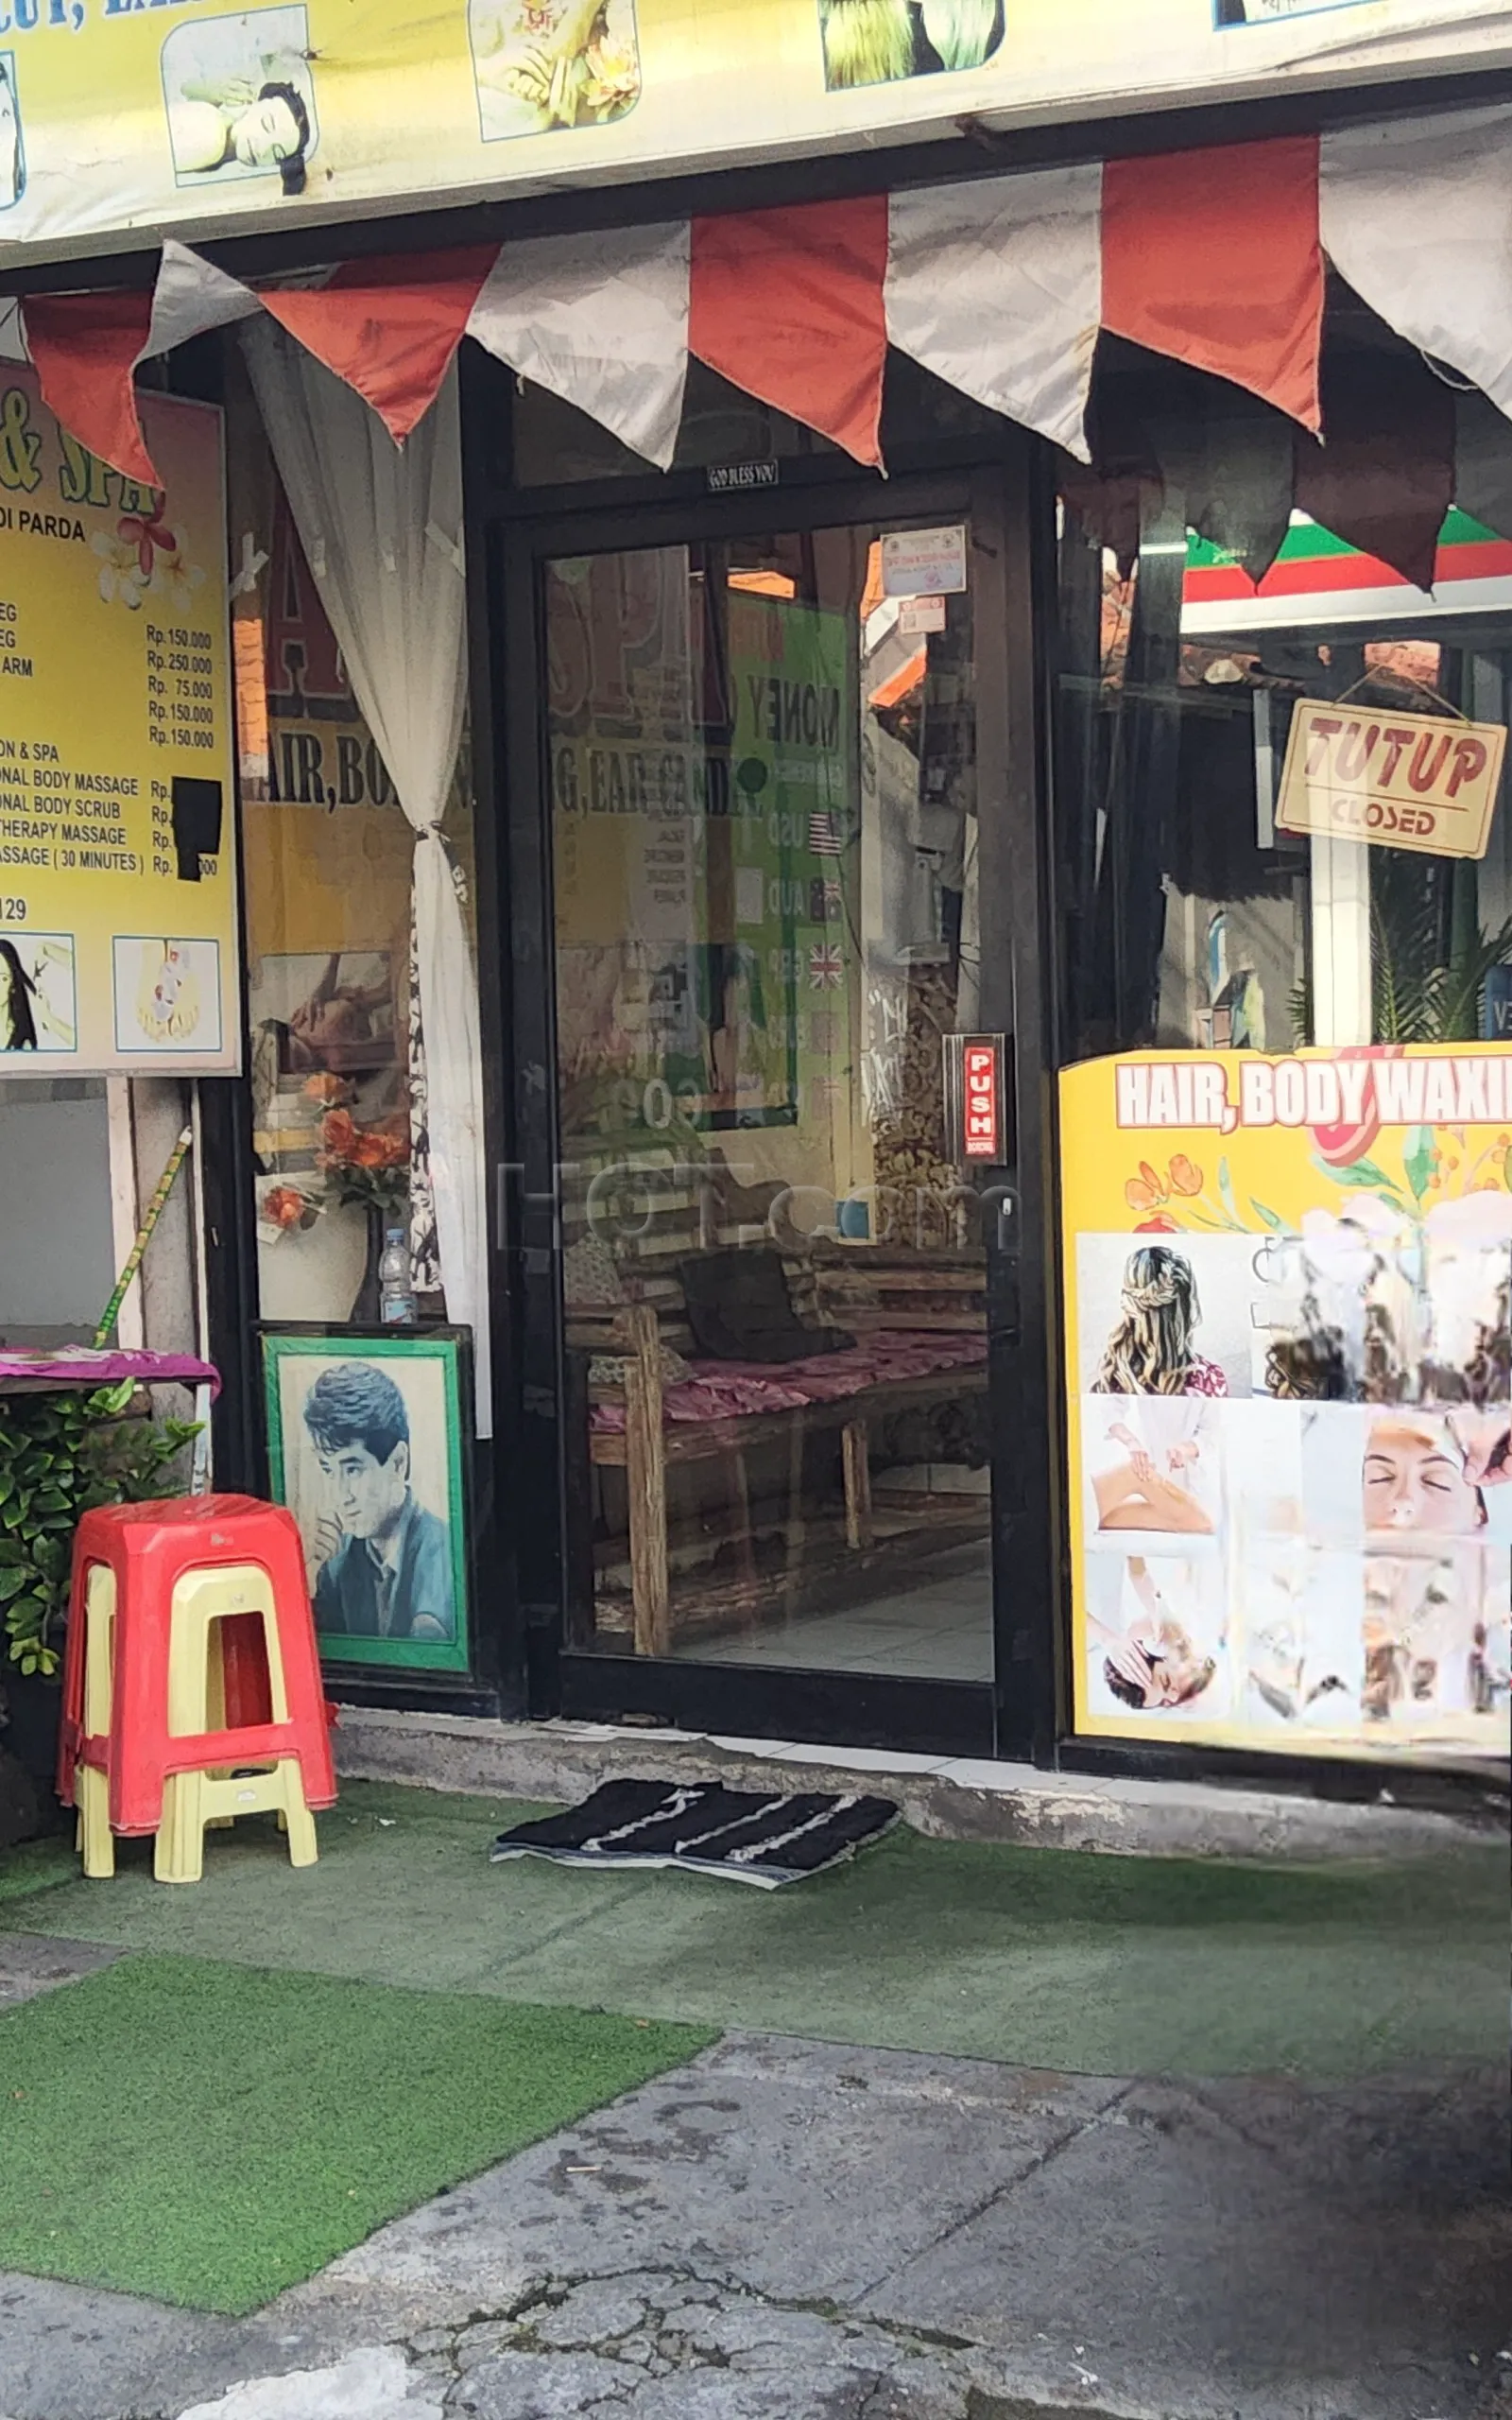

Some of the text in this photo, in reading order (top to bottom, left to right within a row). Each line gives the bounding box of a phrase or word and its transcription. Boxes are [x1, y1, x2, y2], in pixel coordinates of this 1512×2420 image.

[19, 510, 86, 542] PARDA
[146, 624, 212, 650] Rp. 150.000
[2, 656, 33, 677] ARM
[147, 649, 213, 675] Rp. 250.000
[148, 675, 213, 700] Rp. 75.000
[149, 700, 214, 724] Rp. 150.000
[149, 726, 214, 749] Rp. 150.000
[19, 742, 29, 760] &
[32, 743, 60, 762] SPA
[1304, 717, 1487, 799] TUTUP
[0, 767, 139, 796] NAL BODY MASSAGE
[0, 794, 121, 820] NAL BODY SCRUB
[1330, 798, 1435, 836] CLOSED
[61, 824, 126, 845] MASSAGE
[61, 850, 76, 867] 30
[79, 851, 136, 871] MINUTES
[153, 855, 173, 876] Rp.
[970, 1054, 991, 1134] PUSH
[1239, 1058, 1373, 1129] BODY
[1371, 1054, 1512, 1126] WAXI
